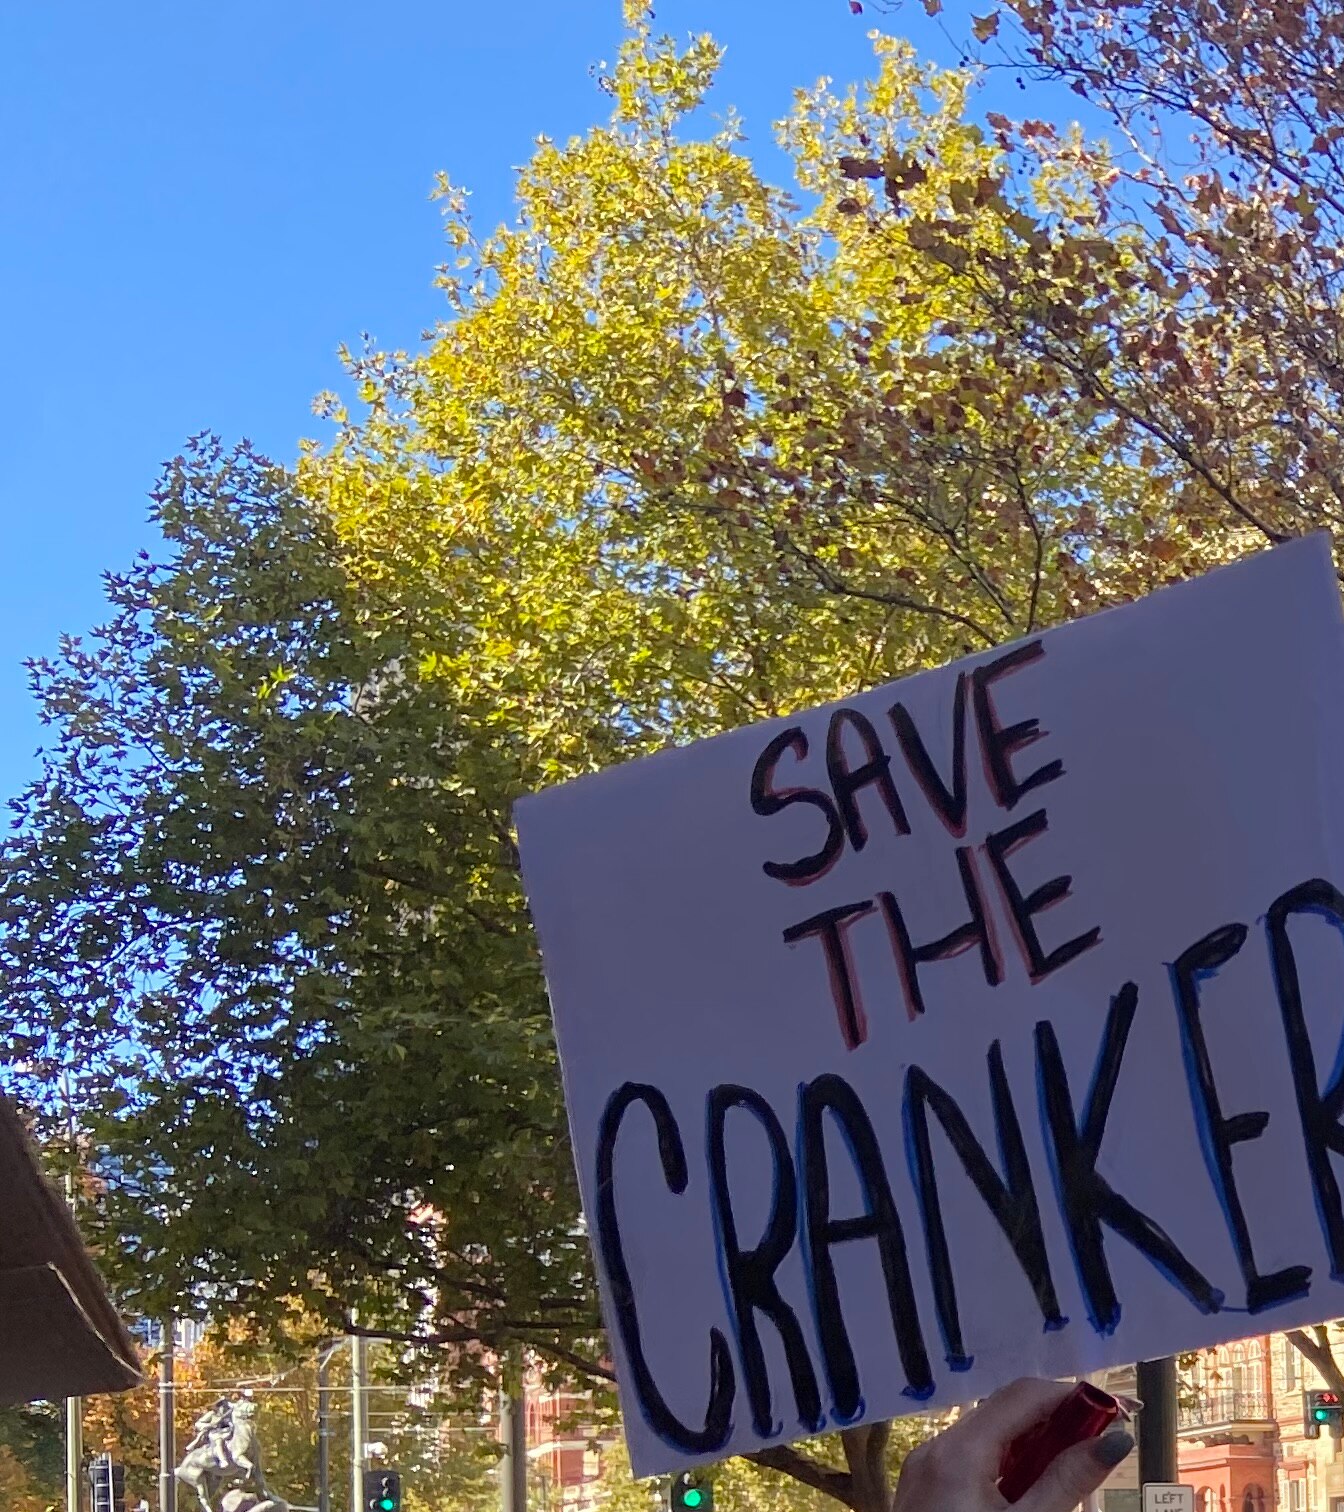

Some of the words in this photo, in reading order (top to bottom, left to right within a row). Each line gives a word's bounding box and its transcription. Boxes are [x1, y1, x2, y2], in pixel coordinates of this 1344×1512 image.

[750, 638, 1065, 888] SAVE
[782, 808, 1104, 1051] THE
[1154, 1493, 1184, 1504] LEFT
